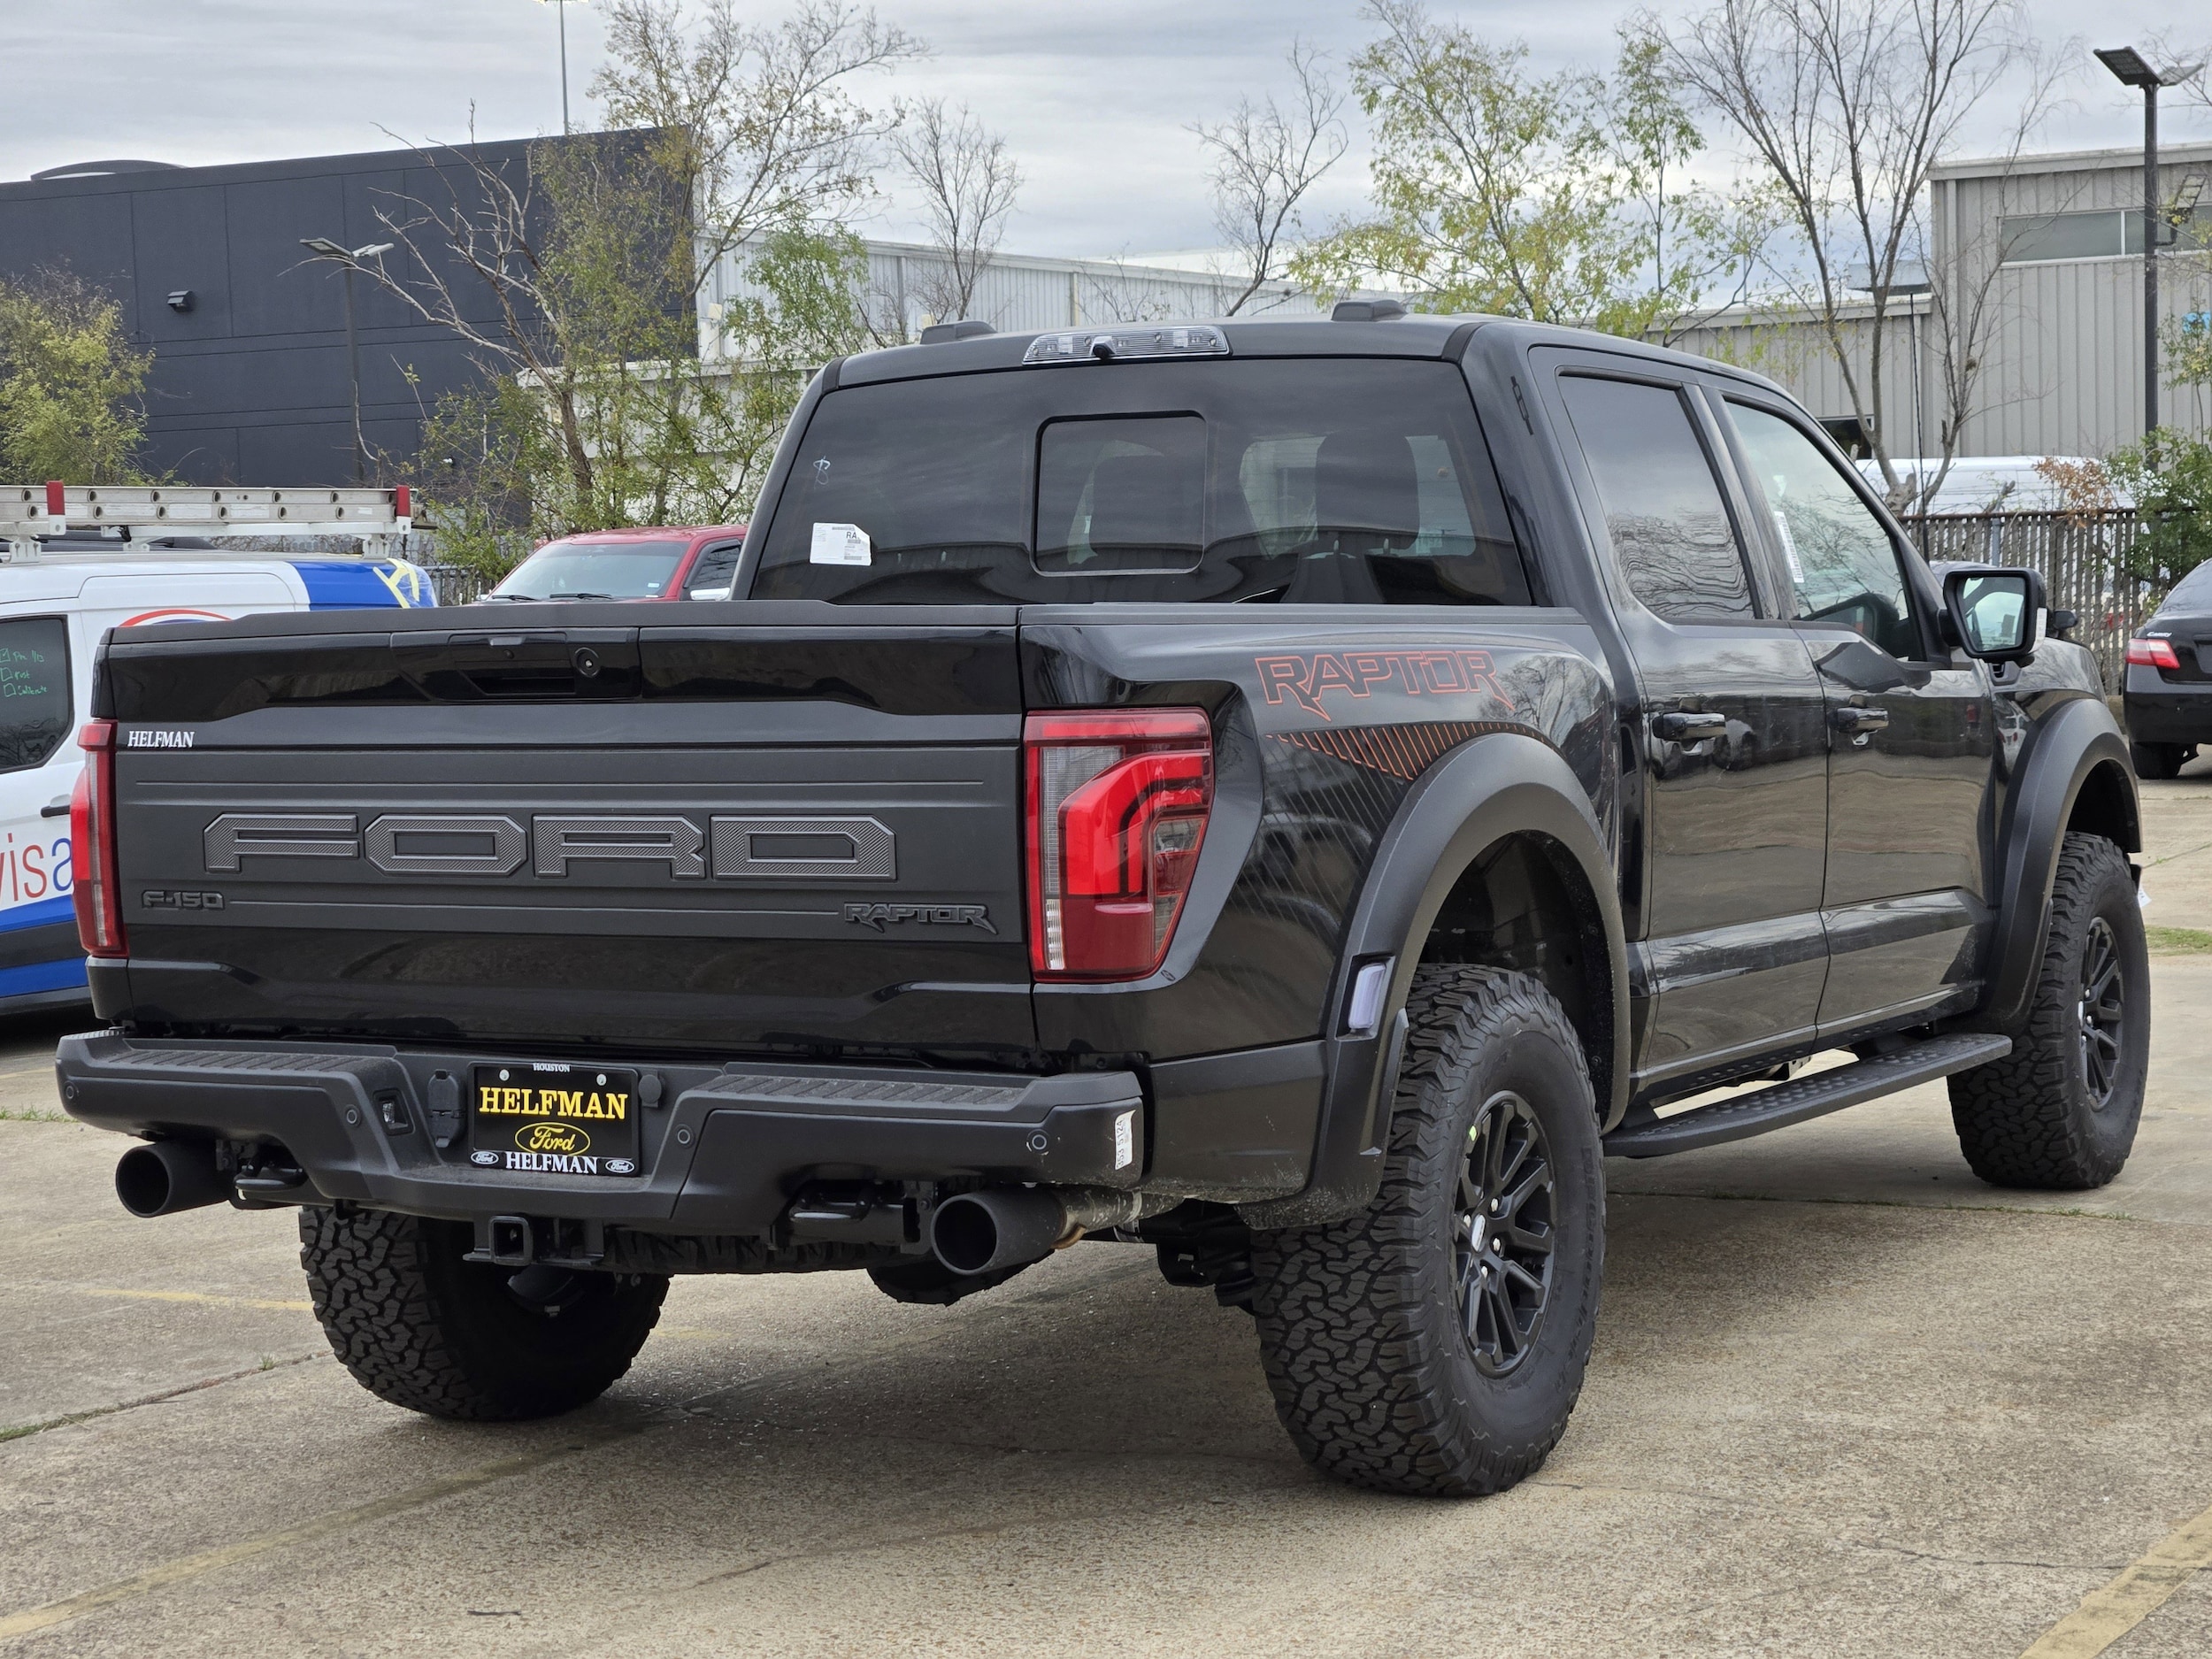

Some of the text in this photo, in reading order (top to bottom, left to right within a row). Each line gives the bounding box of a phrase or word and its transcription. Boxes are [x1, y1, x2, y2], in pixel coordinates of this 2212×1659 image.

[1255, 649, 1515, 722] RAPTOR
[127, 730, 196, 749] HELFMAN
[203, 812, 898, 884] FORD
[141, 889, 225, 910] F-150
[843, 902, 999, 936] RAPTOR
[533, 1062, 571, 1072] HOUSTON
[479, 1086, 629, 1120] HELFMAN
[529, 1125, 577, 1151] Ford
[474, 1153, 495, 1164] Ford
[505, 1150, 598, 1175] HELFMAN
[609, 1162, 631, 1172] Ford
